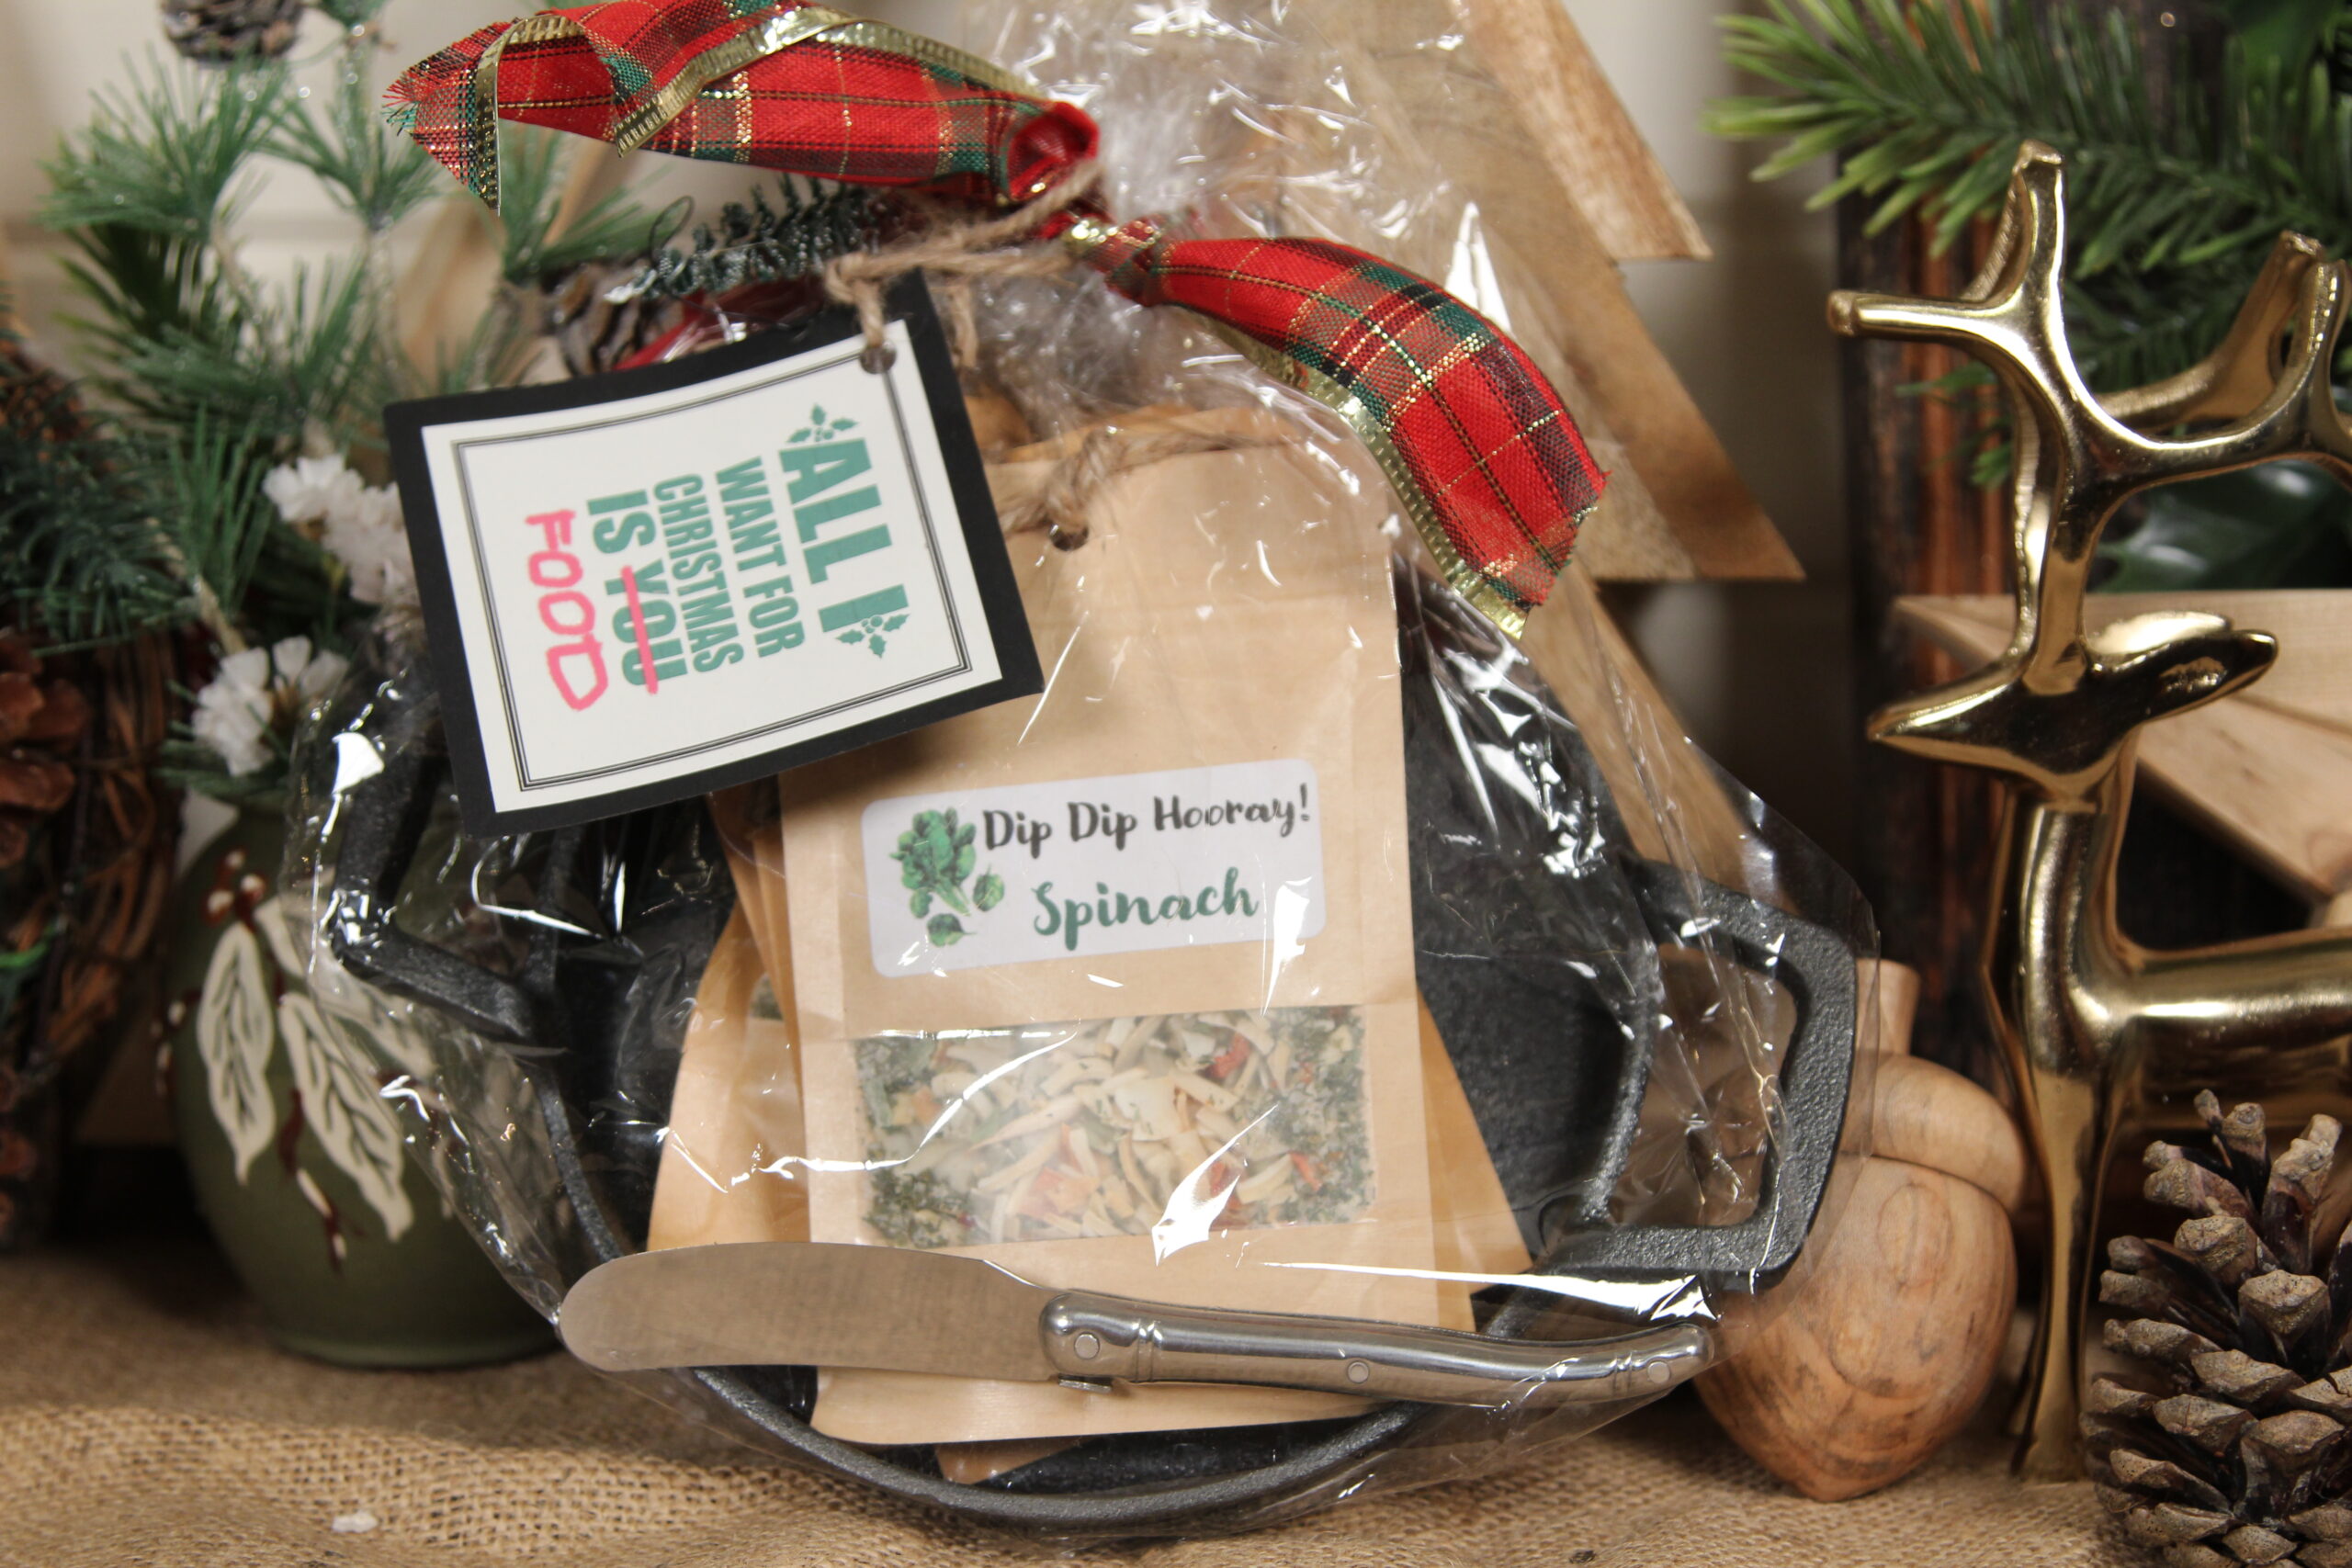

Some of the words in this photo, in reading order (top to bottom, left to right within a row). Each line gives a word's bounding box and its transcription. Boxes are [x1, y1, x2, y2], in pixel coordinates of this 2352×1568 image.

[586, 489, 656, 554] IS
[715, 456, 786, 572] WANT
[778, 438, 893, 584] ALL
[525, 509, 608, 711] FOOD
[605, 559, 688, 685] YOU
[652, 473, 743, 673] CHRISTMAS
[742, 570, 806, 658] FOR
[818, 584, 909, 633] I
[982, 809, 1052, 859] Dip
[1068, 802, 1137, 851] Dip
[1153, 783, 1311, 837] Hooray!
[1031, 867, 1259, 952] Spinach
